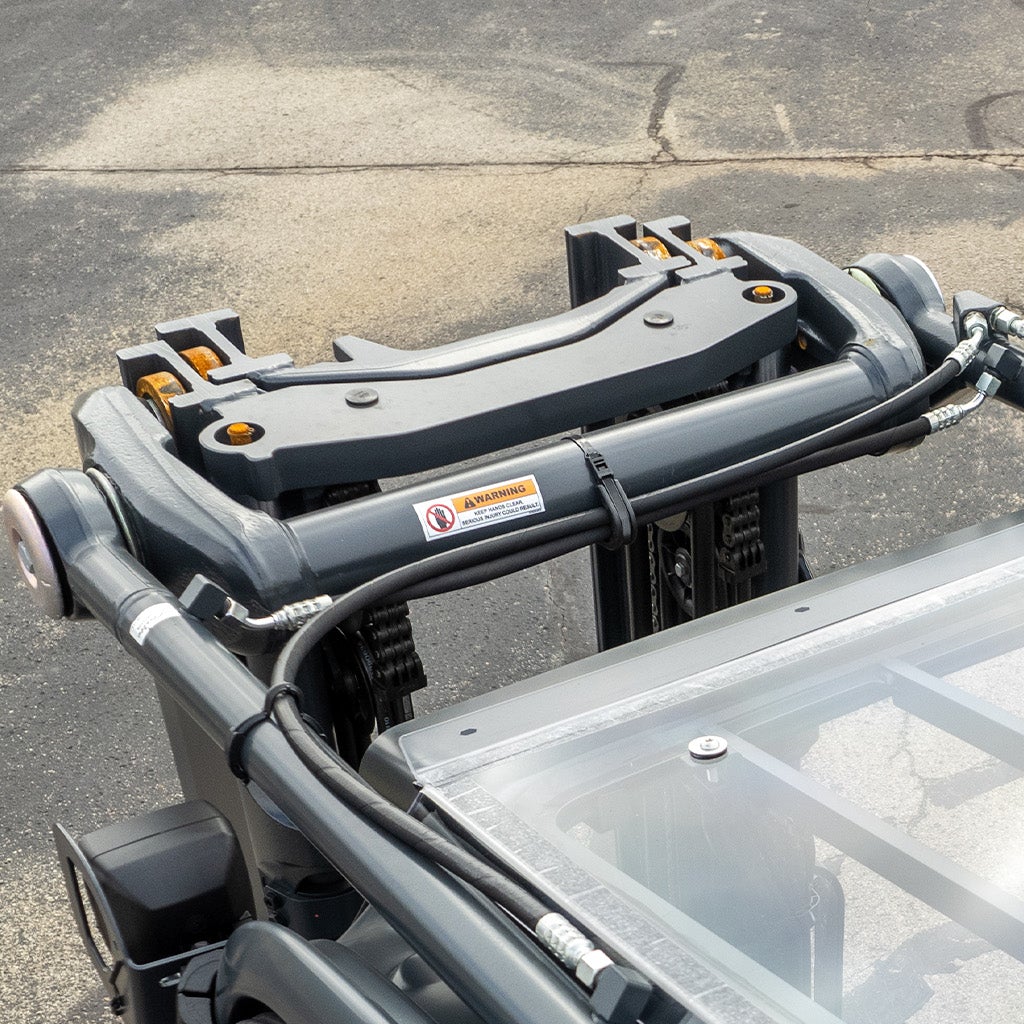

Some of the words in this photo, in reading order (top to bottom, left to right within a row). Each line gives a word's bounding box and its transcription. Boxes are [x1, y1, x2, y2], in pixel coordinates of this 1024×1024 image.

[474, 485, 526, 504] WARNING
[462, 516, 484, 526] SERIOUS
[484, 511, 501, 521] INJURY
[502, 507, 519, 516] COULD
[474, 508, 487, 516] KEEP
[488, 504, 505, 512] HANDS
